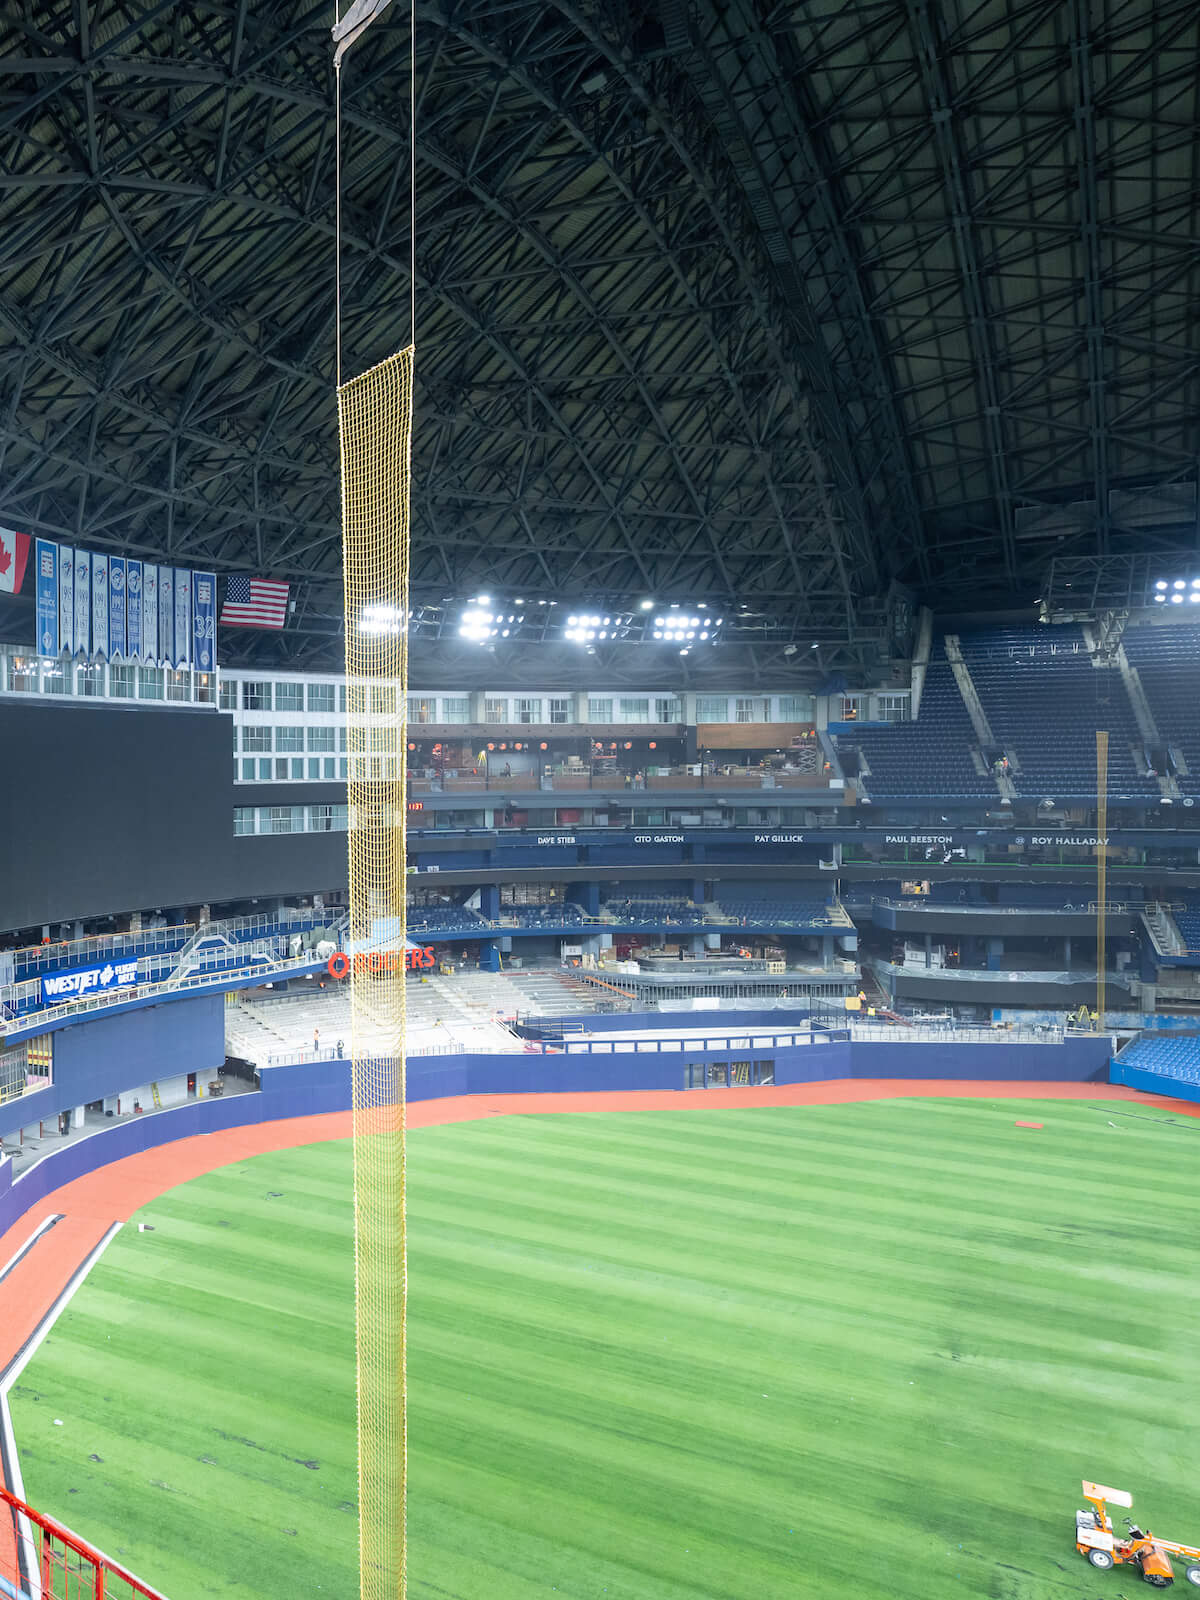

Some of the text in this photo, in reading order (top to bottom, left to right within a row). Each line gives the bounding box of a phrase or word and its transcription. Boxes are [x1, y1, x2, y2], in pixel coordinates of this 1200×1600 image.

[193, 615, 214, 638] 32
[537, 836, 576, 844] DAVE STIEB
[634, 835, 684, 843] CITO GASTON
[754, 835, 803, 843] PAT GILLICK
[885, 835, 953, 844] PAUL BEESTON
[1031, 837, 1053, 845] ROY
[1055, 837, 1110, 846] HALLADAY
[115, 962, 138, 975] FLIGHT
[44, 970, 100, 995] WESTJET
[118, 972, 136, 984] DECK
